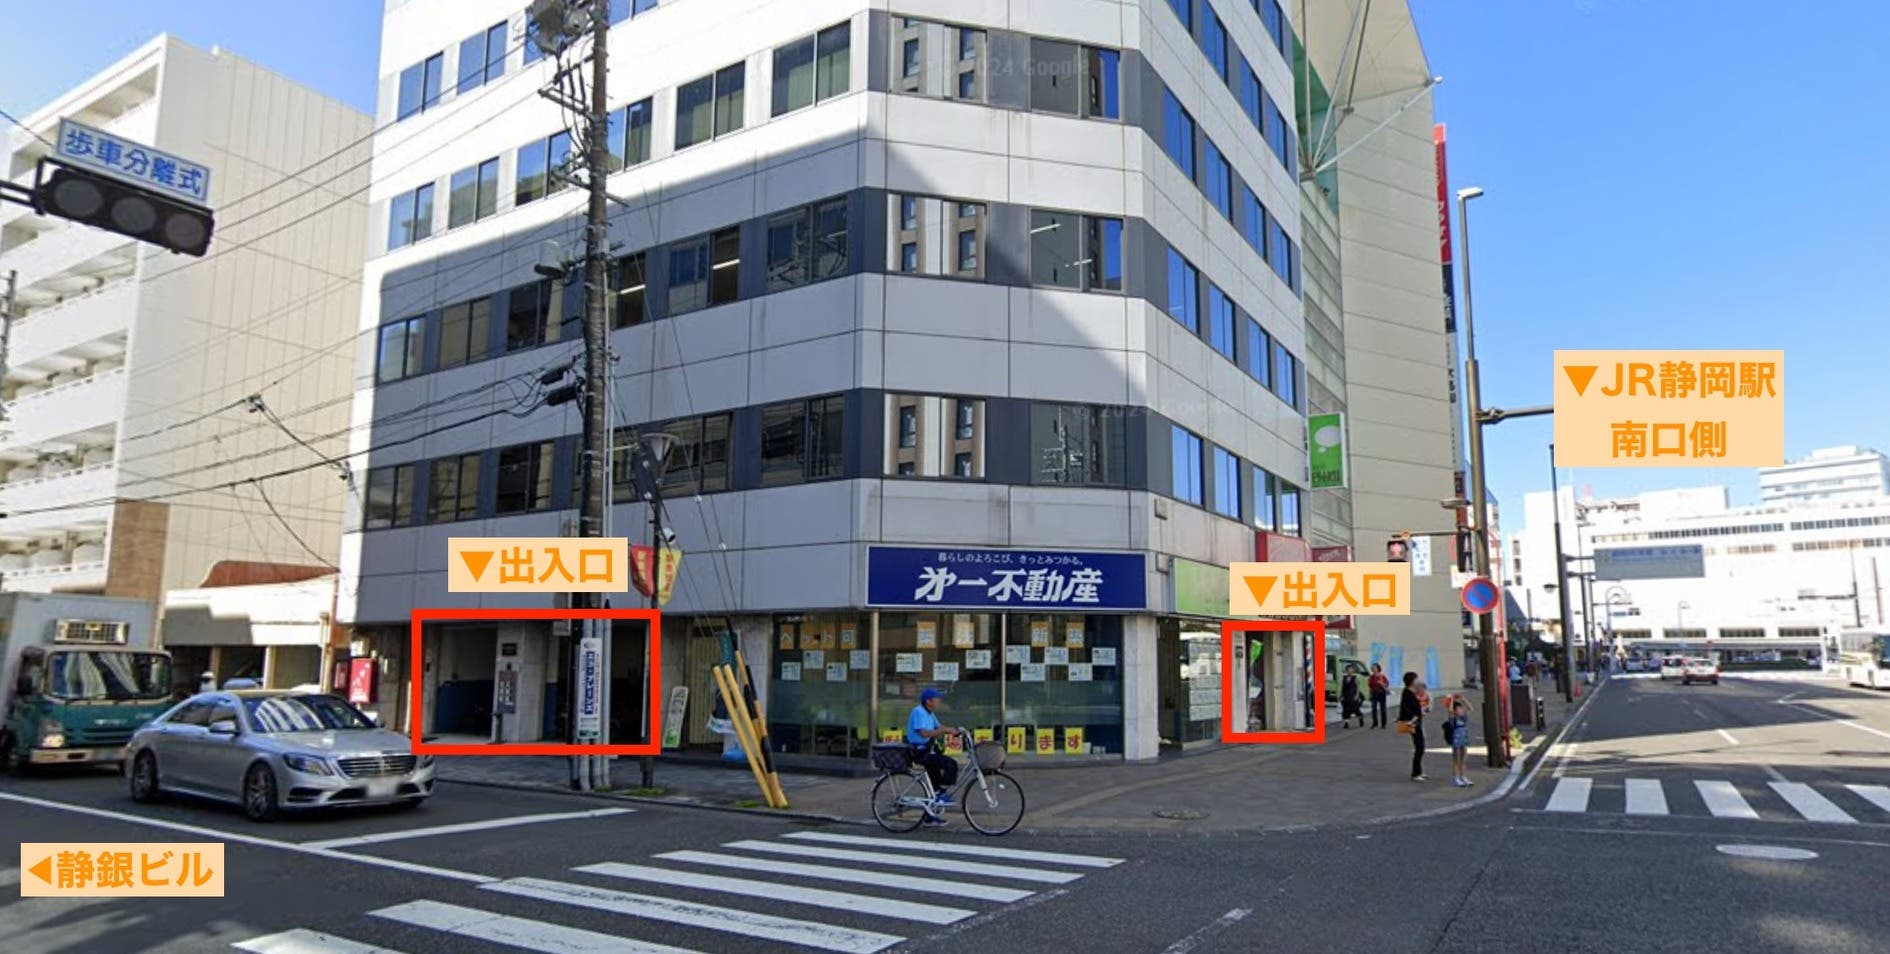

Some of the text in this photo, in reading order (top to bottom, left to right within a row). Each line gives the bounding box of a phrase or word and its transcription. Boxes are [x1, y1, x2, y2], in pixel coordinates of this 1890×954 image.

[65, 128, 203, 195] 歩車分離式
